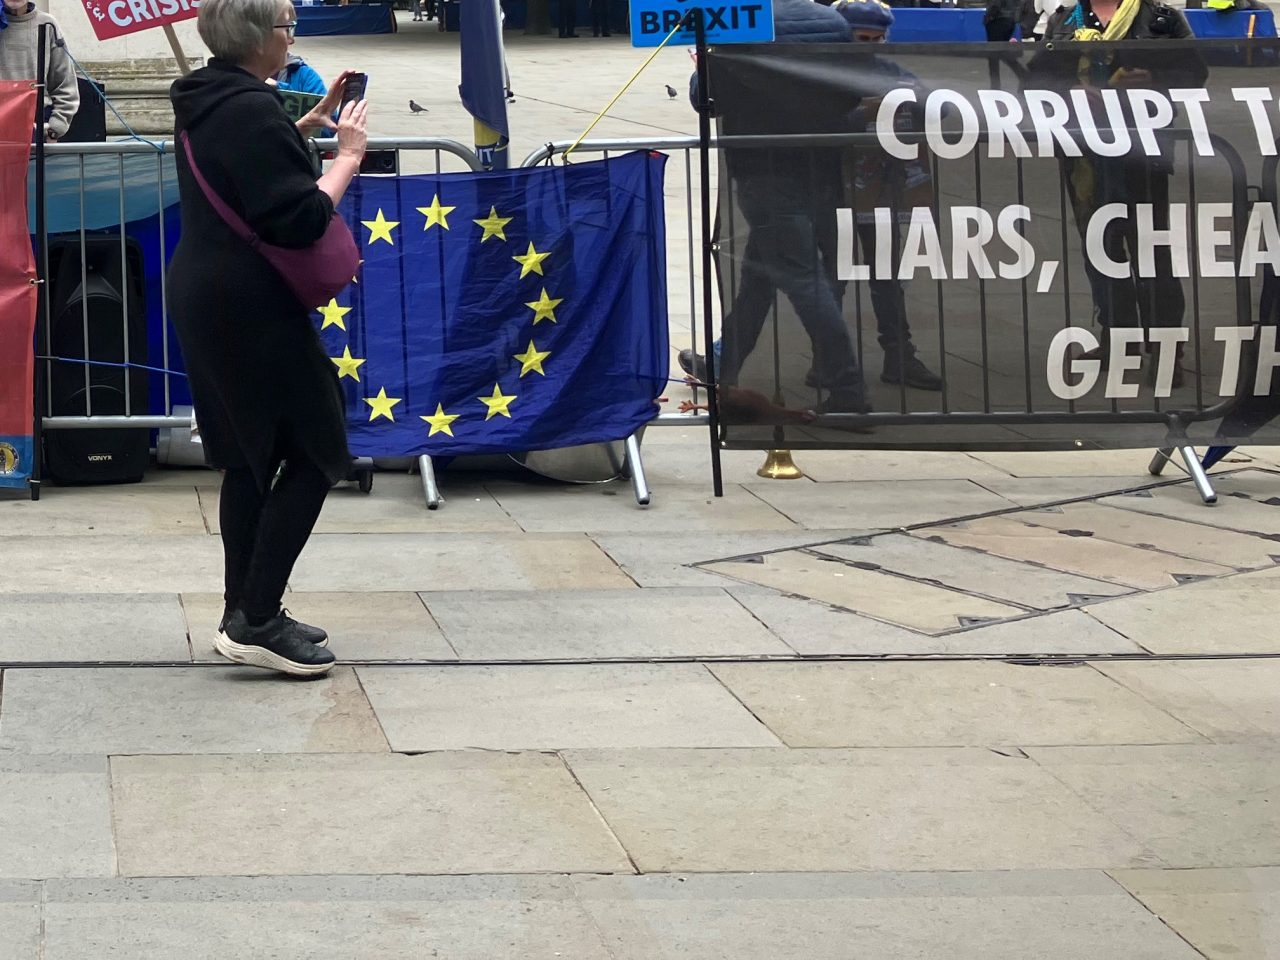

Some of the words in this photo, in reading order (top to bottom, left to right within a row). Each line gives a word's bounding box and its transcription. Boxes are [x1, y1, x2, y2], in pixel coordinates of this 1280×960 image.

[876, 88, 1215, 160] CORRUPT
[836, 204, 1059, 293] LIARS,
[1046, 326, 1189, 400] GET
